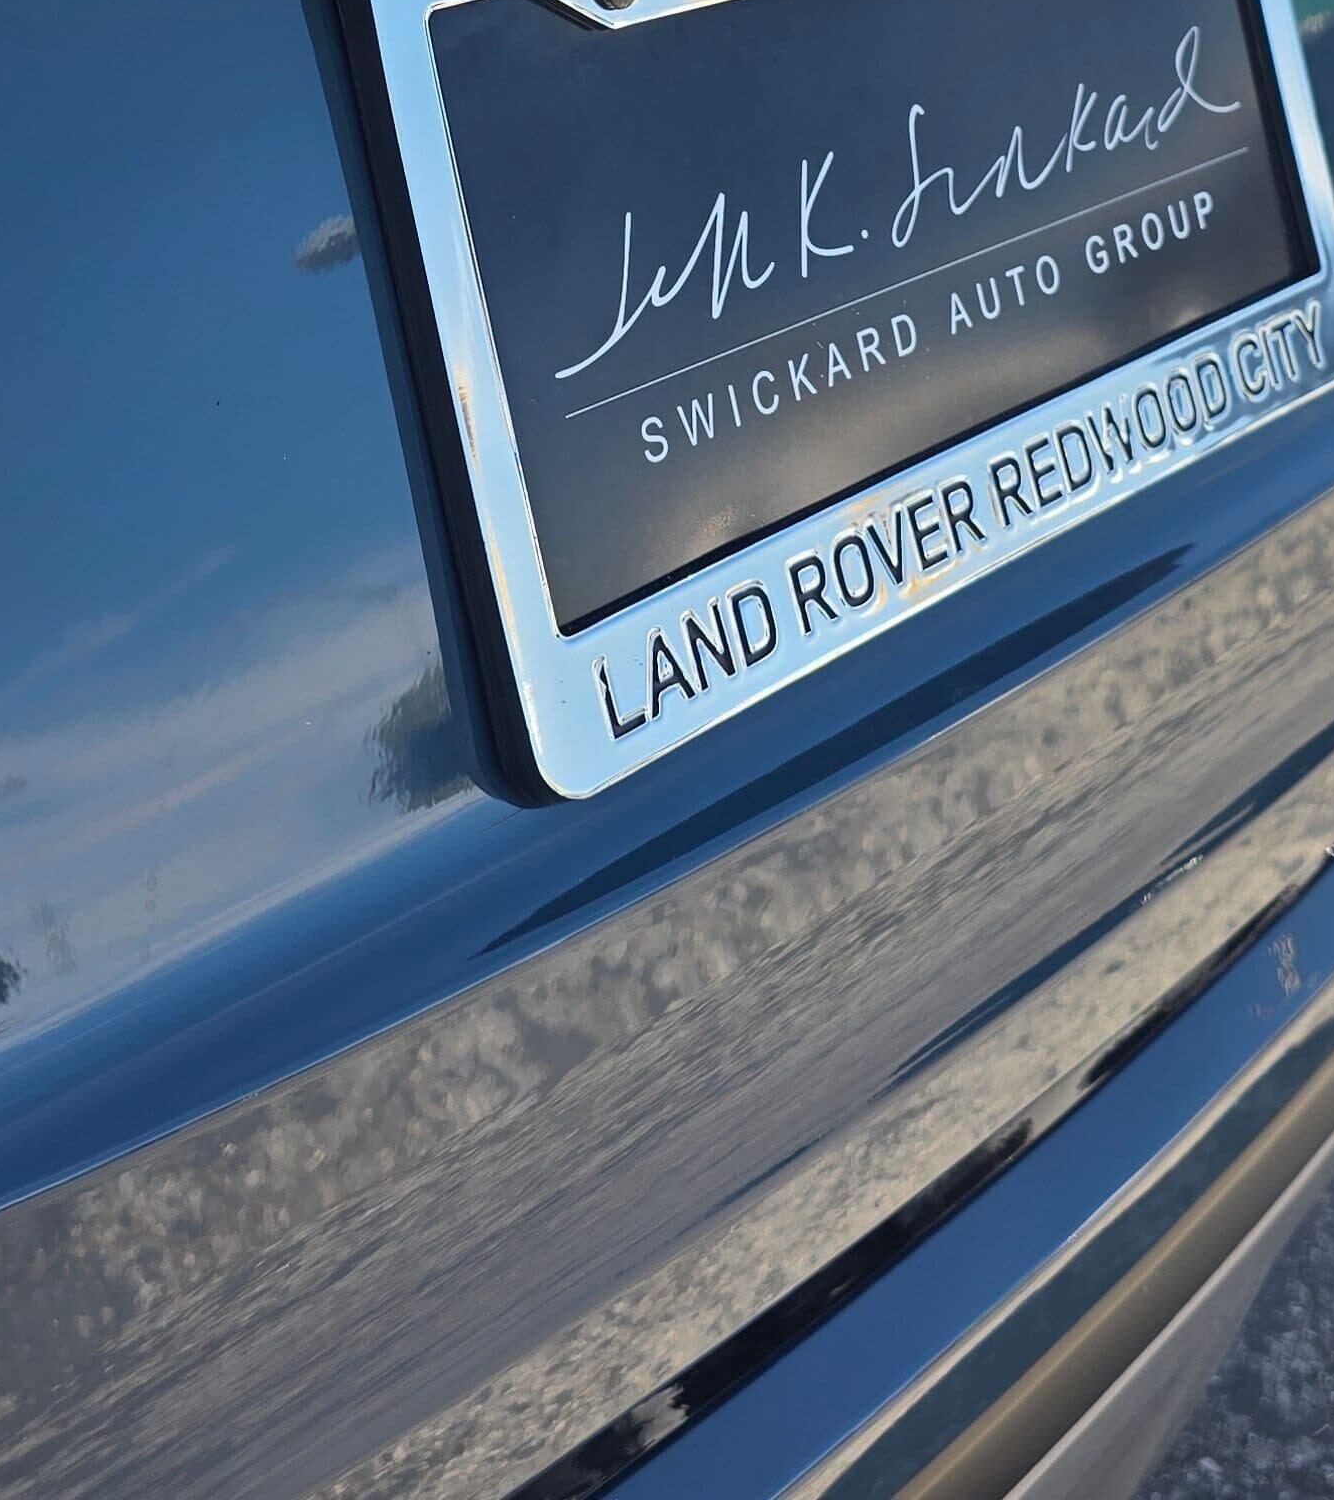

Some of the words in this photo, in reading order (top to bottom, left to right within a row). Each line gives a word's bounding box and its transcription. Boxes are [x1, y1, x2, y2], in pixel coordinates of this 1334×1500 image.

[642, 312, 919, 464] SWICKARD
[948, 254, 1061, 349] AUTO
[1083, 189, 1216, 277] GROUP
[801, 150, 870, 279] K.
[592, 578, 778, 742] LAND
[785, 474, 987, 637] ROVER
[987, 349, 1229, 529] REDWOOD
[1230, 299, 1324, 402] CITY
